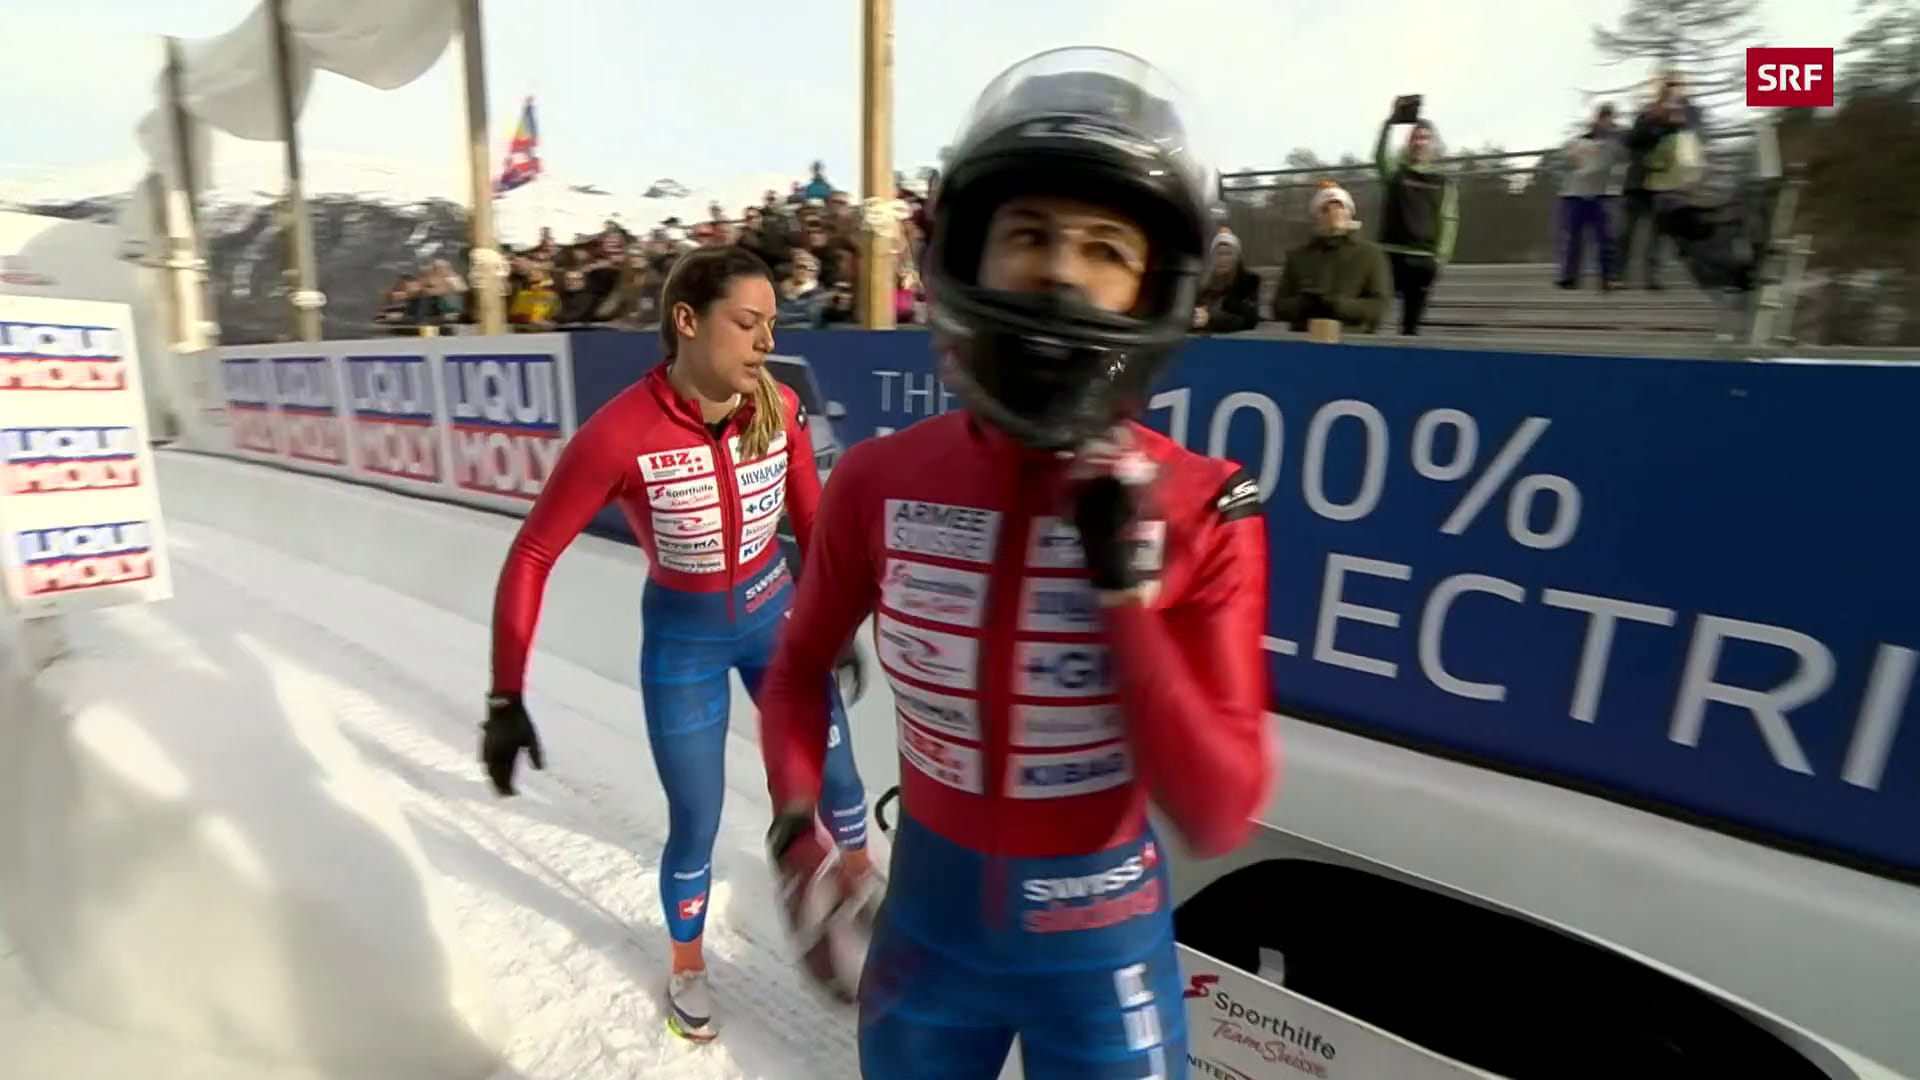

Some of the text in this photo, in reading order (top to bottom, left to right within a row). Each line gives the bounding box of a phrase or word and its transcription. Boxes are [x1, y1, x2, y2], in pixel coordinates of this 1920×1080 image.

[447, 361, 557, 424] LIQUI
[648, 451, 690, 470] IBZ
[1149, 386, 1583, 551] 100%
[1260, 553, 1919, 791] ECTRI
[1215, 992, 1337, 1060] Sporthilfe
